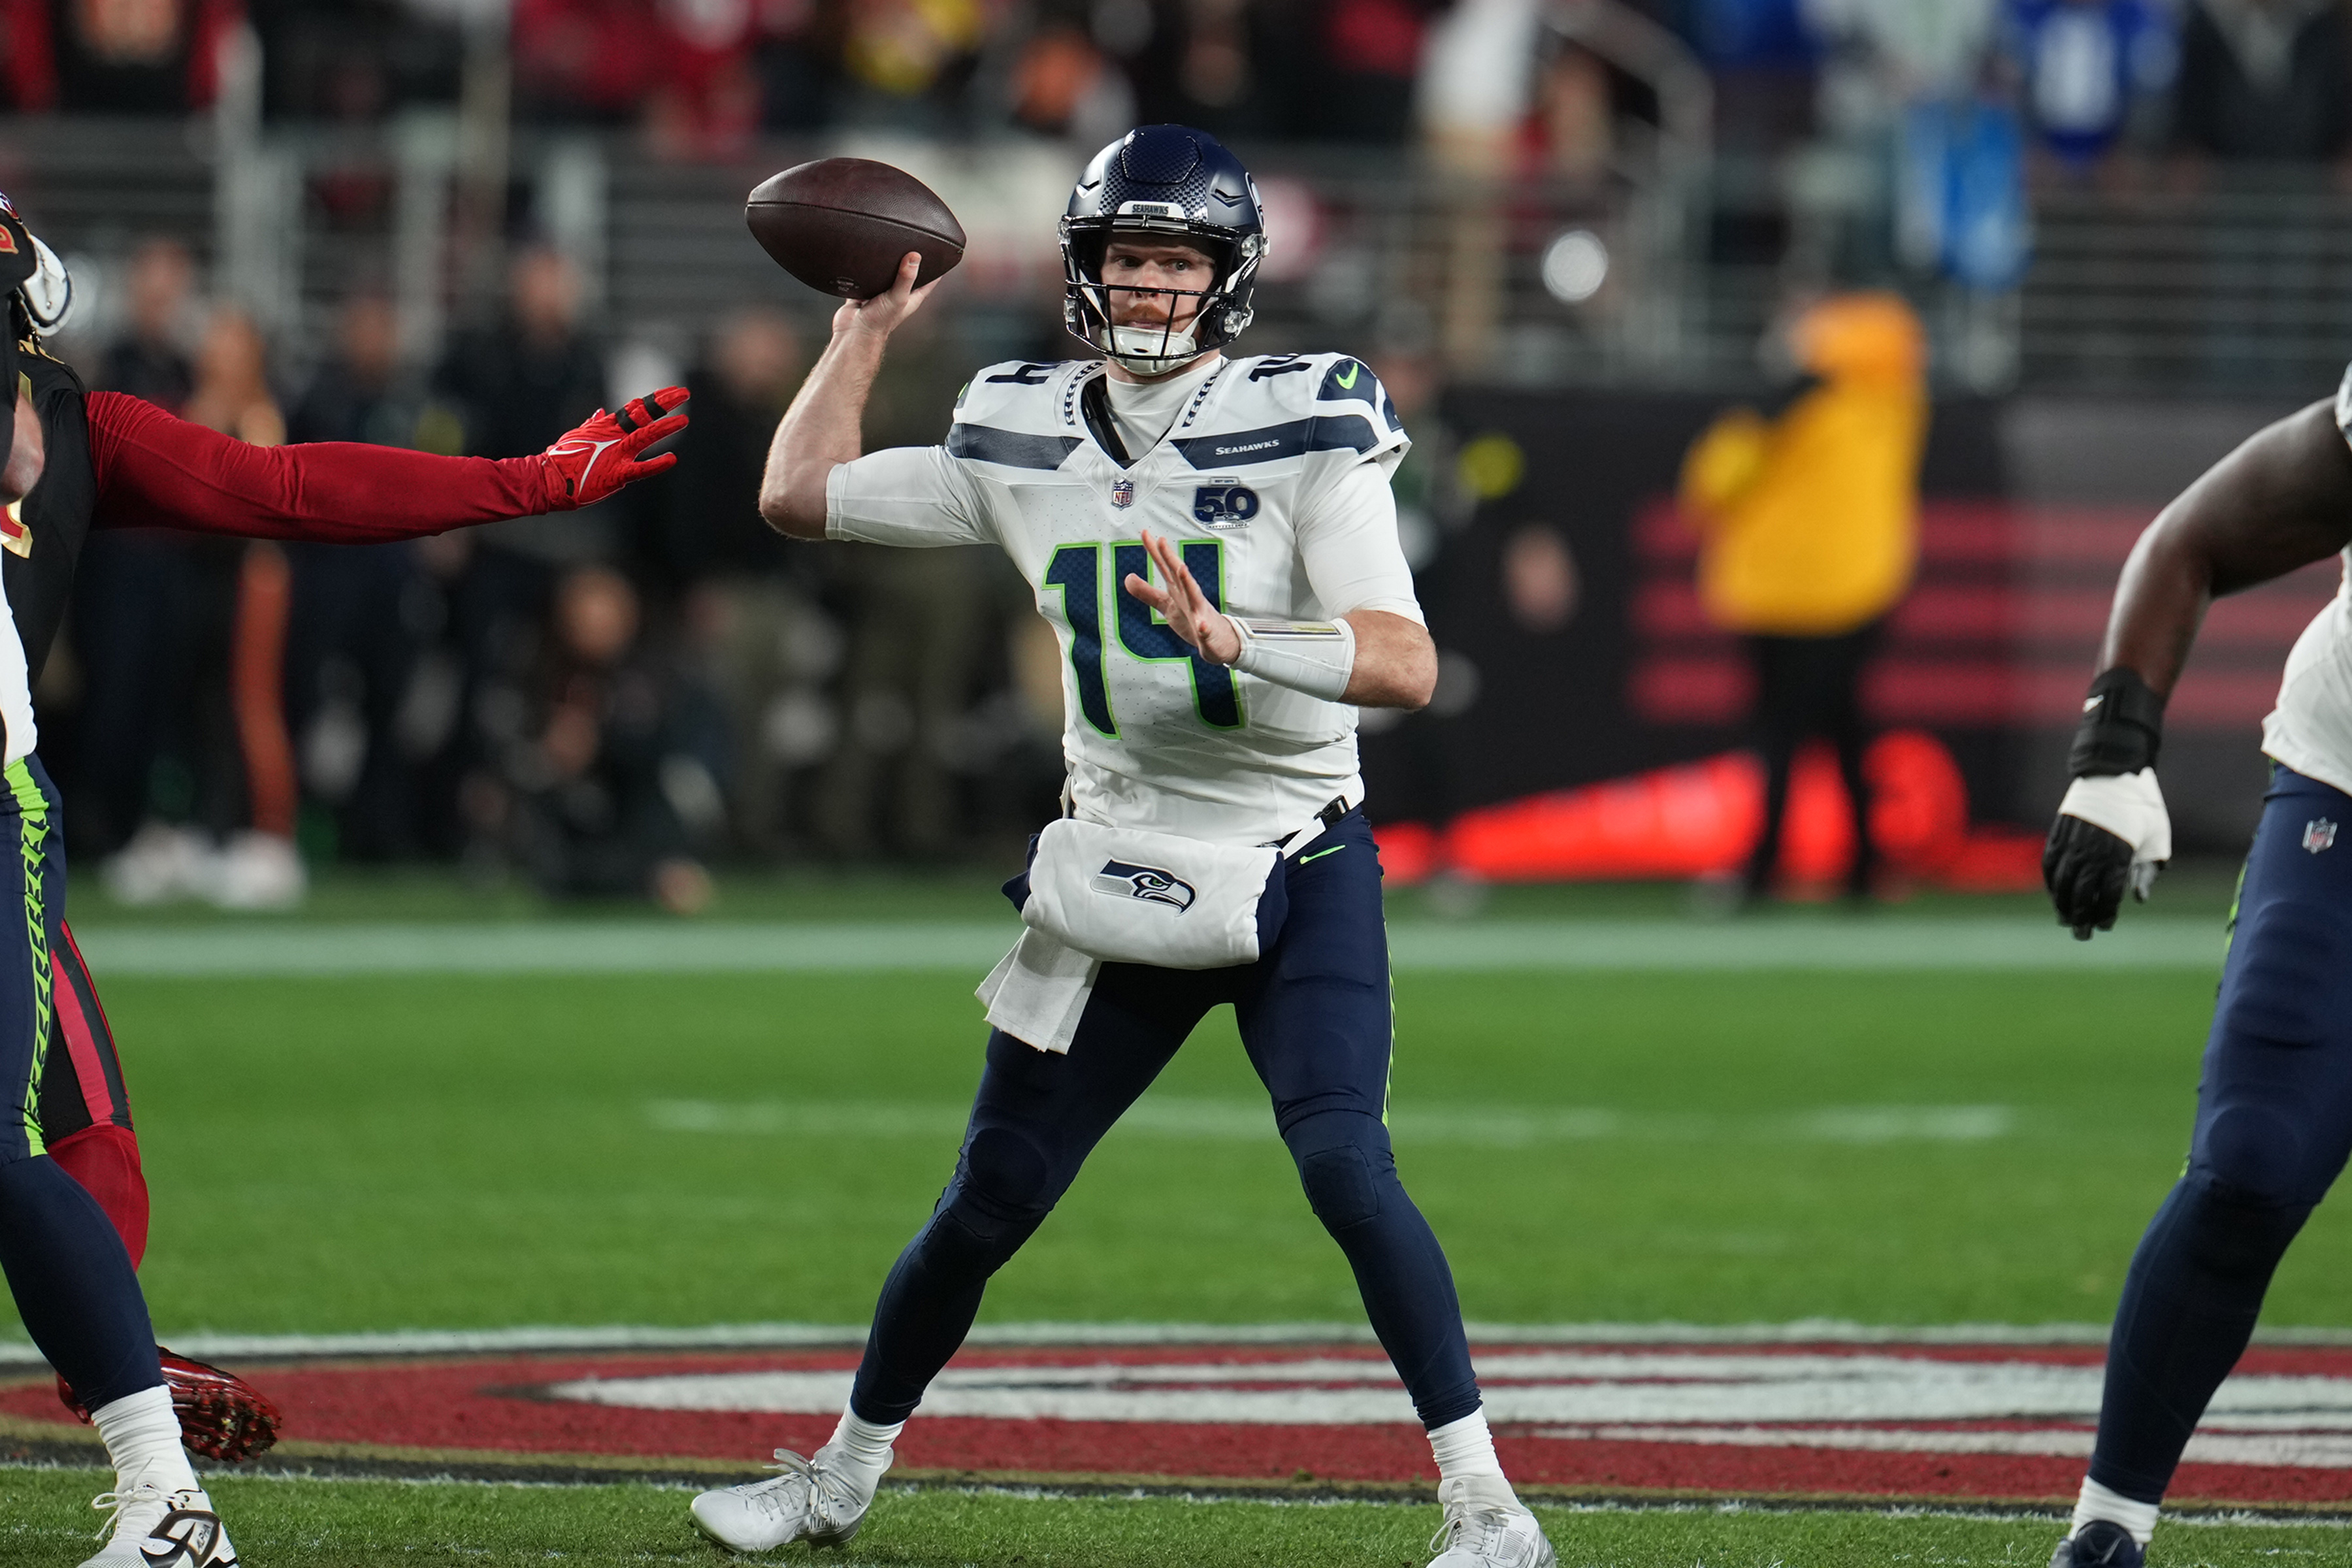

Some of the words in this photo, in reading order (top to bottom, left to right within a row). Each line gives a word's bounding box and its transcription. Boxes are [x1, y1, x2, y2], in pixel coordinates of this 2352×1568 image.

[1132, 204, 1169, 215] SEAHAWKS
[985, 360, 1071, 385] 4
[1215, 439, 1280, 455] SEAHAWKS
[1114, 492, 1130, 504] NFL
[1194, 487, 1260, 522] 50
[1041, 538, 1245, 740] 14
